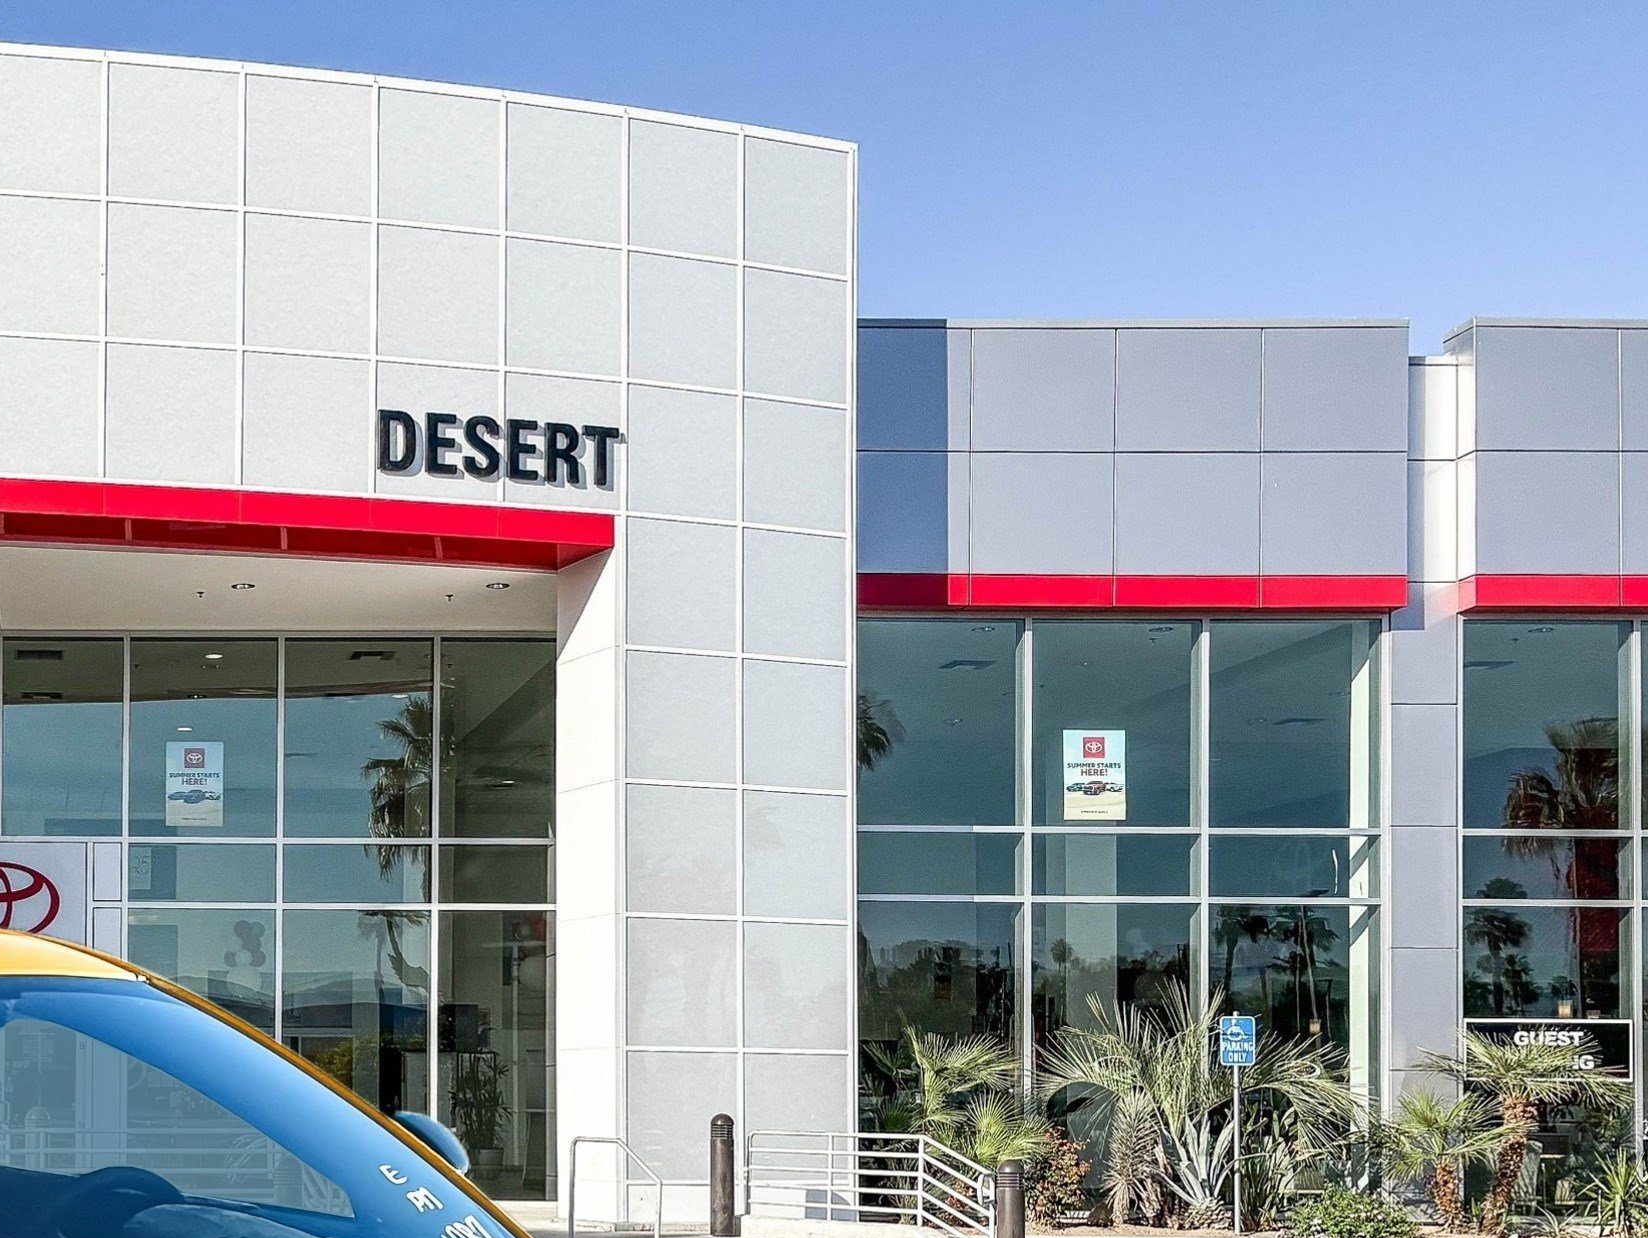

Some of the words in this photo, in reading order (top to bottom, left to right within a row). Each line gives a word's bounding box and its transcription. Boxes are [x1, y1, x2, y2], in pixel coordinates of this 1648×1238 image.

[377, 409, 620, 487] DESERT
[1081, 769, 1108, 777] HERE!
[181, 778, 207, 786] HERE!
[1513, 1030, 1584, 1047] GUEST
[1222, 1041, 1253, 1052] PARKING
[1228, 1051, 1247, 1063] ONLY
